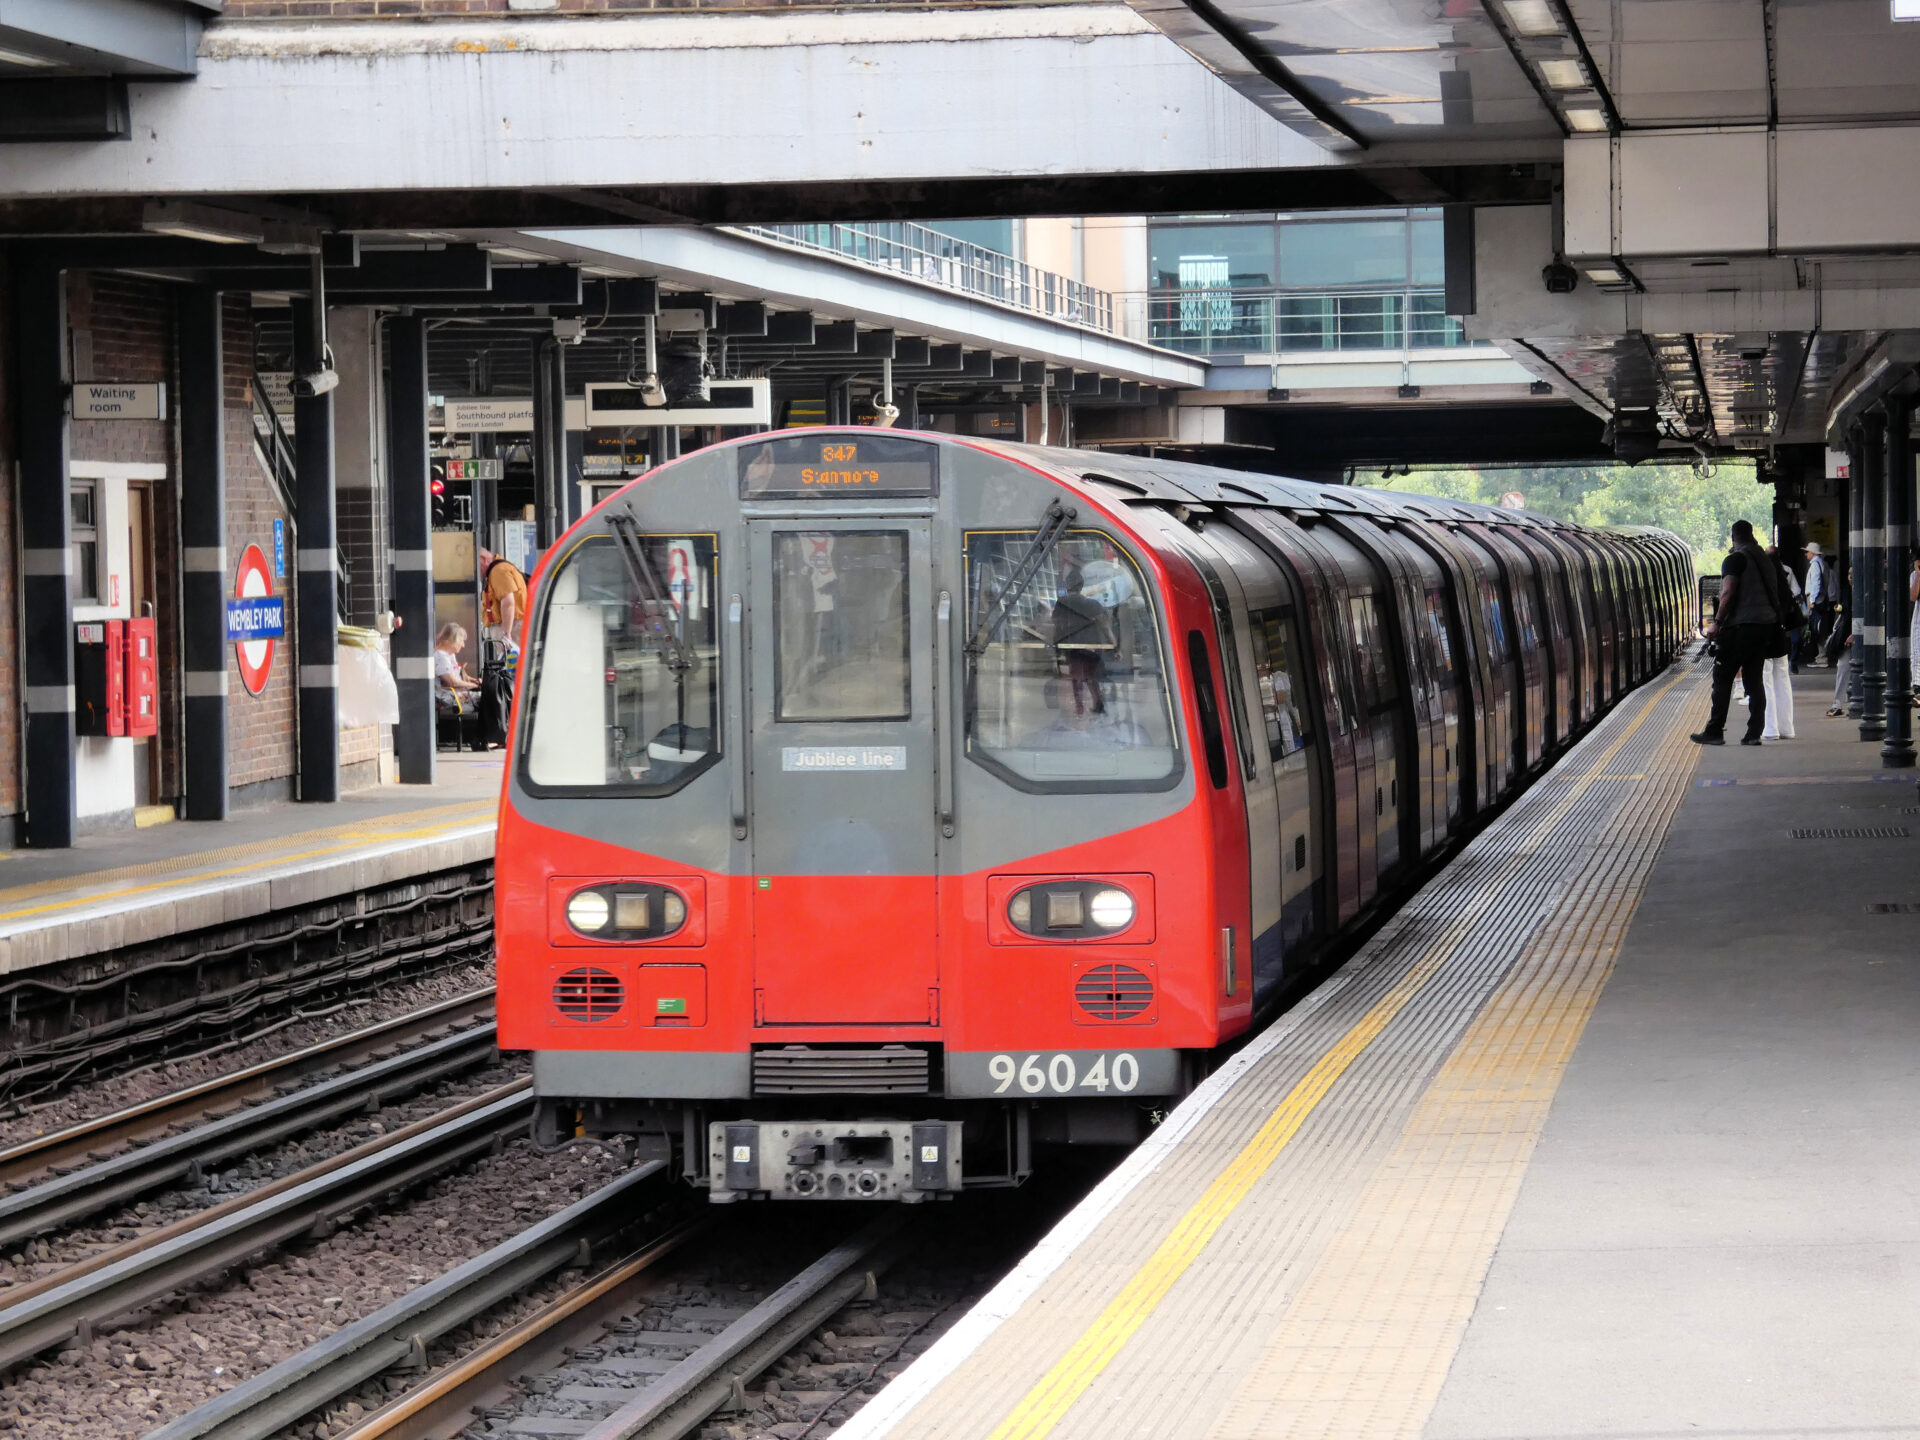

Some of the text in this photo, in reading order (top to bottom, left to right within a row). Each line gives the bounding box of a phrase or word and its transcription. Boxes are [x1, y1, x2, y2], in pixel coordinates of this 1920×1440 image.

[89, 387, 136, 400] Waiting
[89, 403, 122, 412] room
[456, 411, 534, 420] Southbound platfo
[586, 455, 608, 467] Way
[823, 445, 857, 463] 347
[227, 606, 282, 632] WEMBLEY PARK
[795, 751, 894, 767] Jubilee line
[988, 1053, 1140, 1094] 96040
